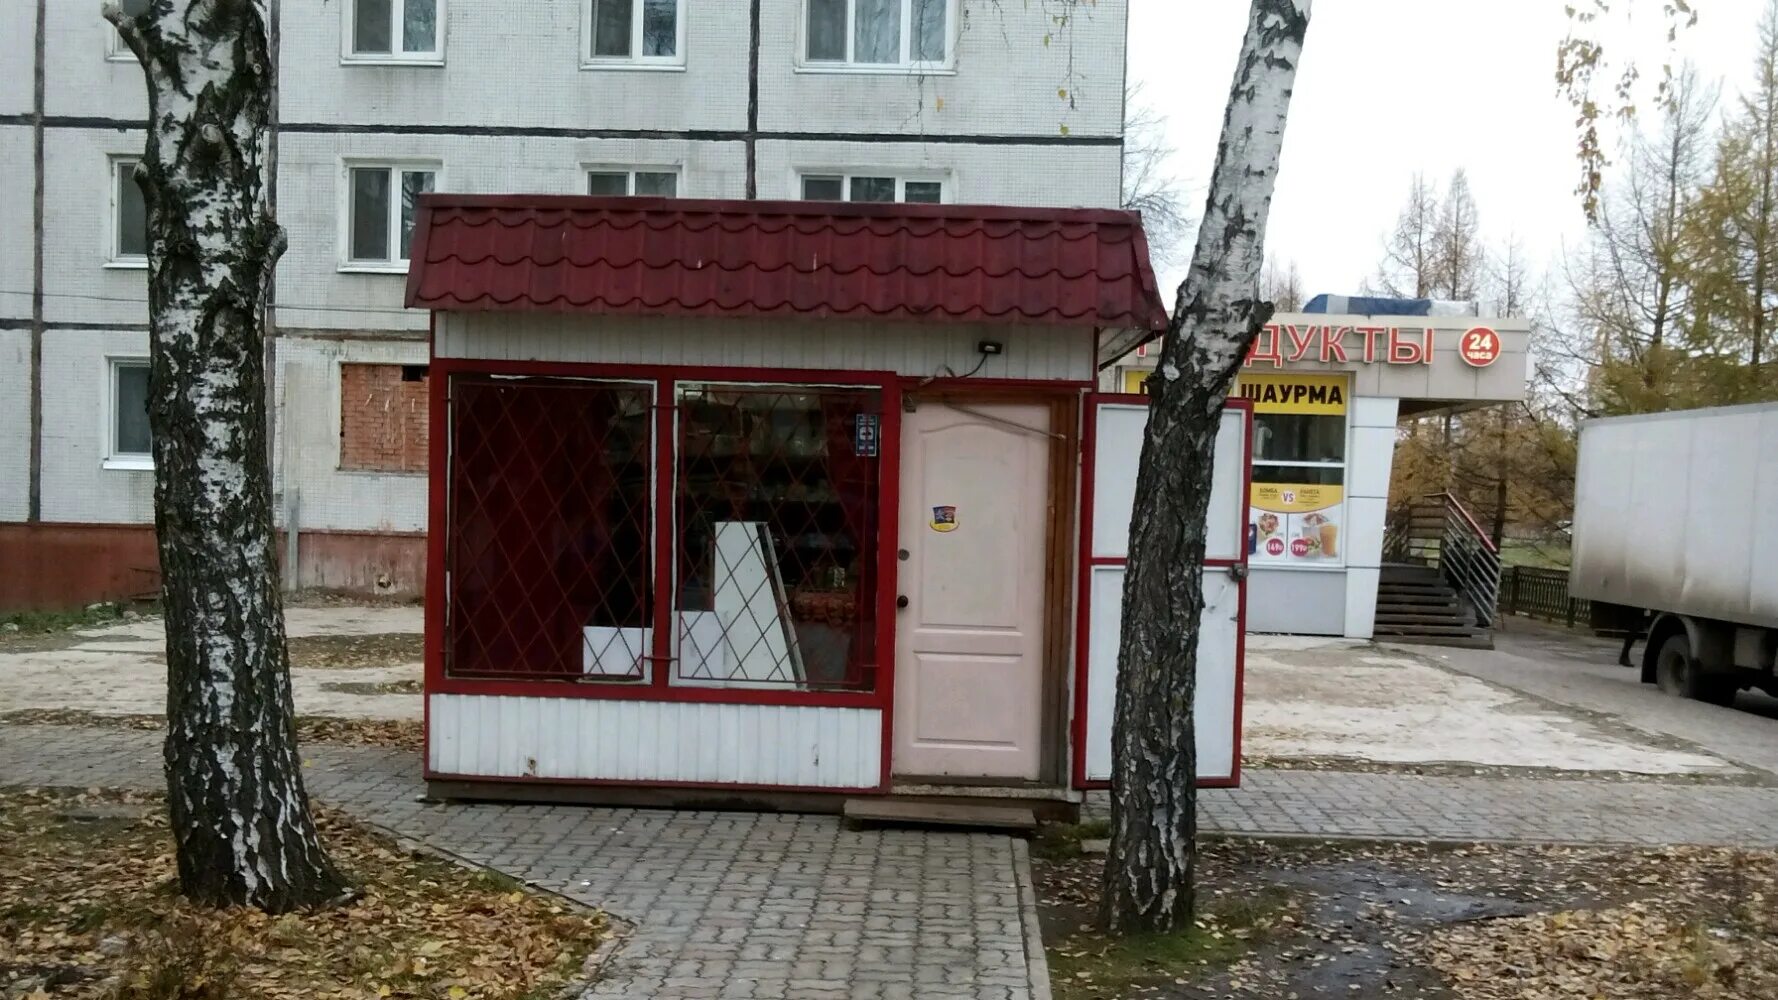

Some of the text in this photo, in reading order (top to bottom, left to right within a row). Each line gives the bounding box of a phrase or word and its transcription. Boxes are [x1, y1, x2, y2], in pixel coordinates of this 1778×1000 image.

[1469, 333, 1492, 350] 24
[1467, 350, 1493, 361] часа
[1240, 383, 1344, 405] ШАУРМА
[1283, 493, 1294, 503] VS
